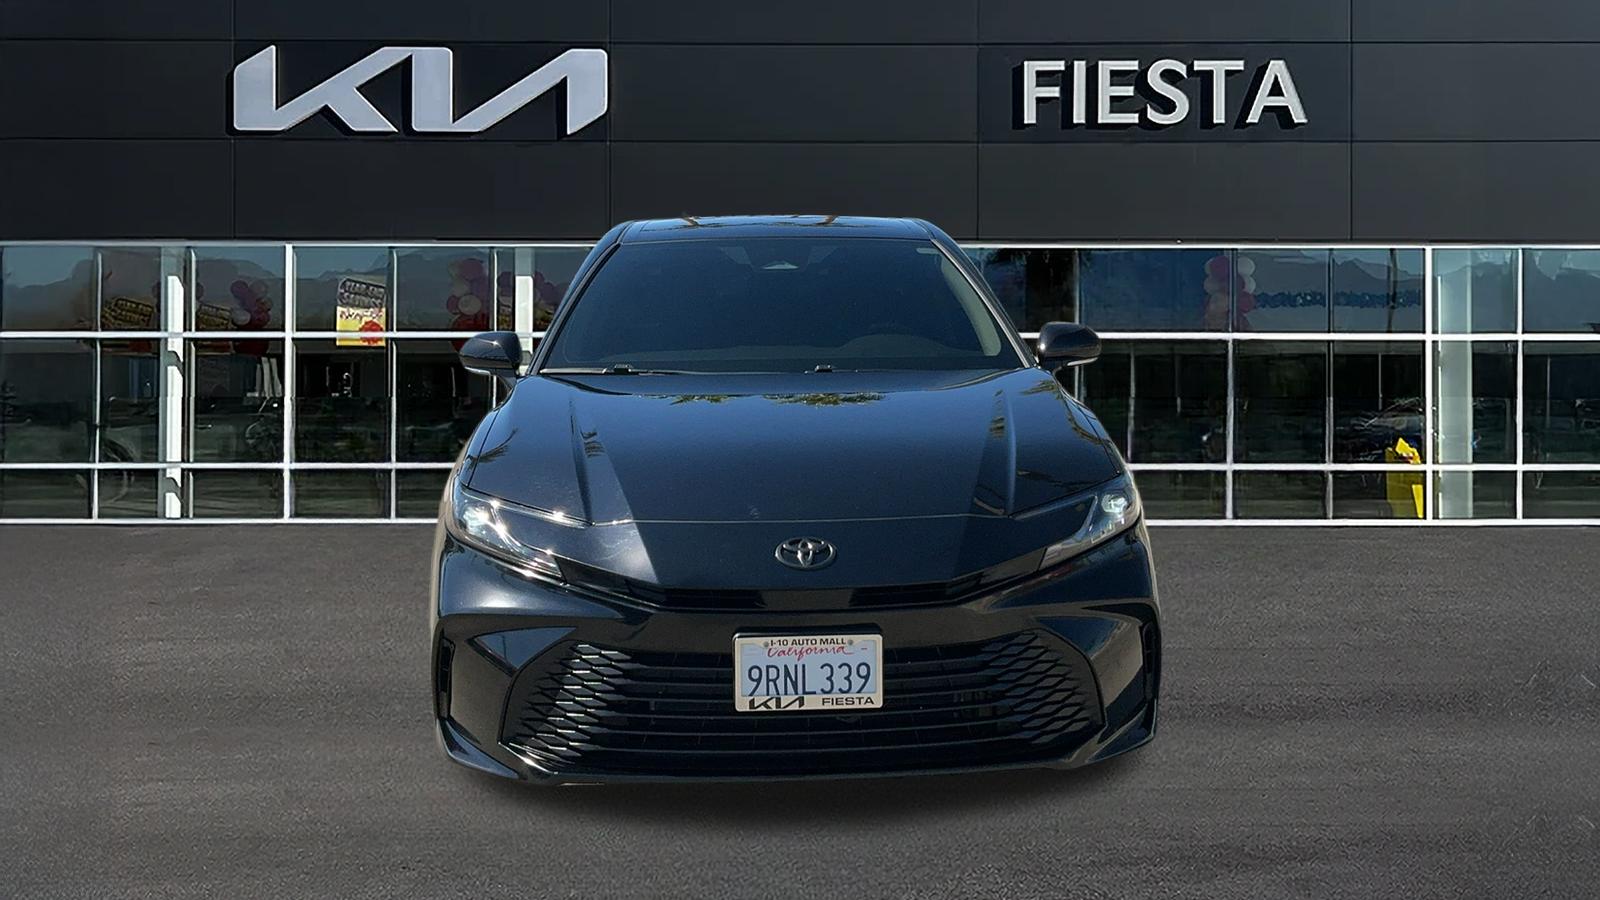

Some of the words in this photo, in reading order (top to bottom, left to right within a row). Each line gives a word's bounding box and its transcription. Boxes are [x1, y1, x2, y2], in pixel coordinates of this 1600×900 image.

[233, 44, 608, 135] KIA
[1023, 58, 1308, 125] FIESTA
[767, 645, 854, 662] California
[770, 639, 789, 647] I-10
[790, 638, 818, 646] AUTO
[819, 637, 846, 646] MALL
[747, 661, 871, 697] 9RNL339
[821, 696, 875, 706] FIESTA
